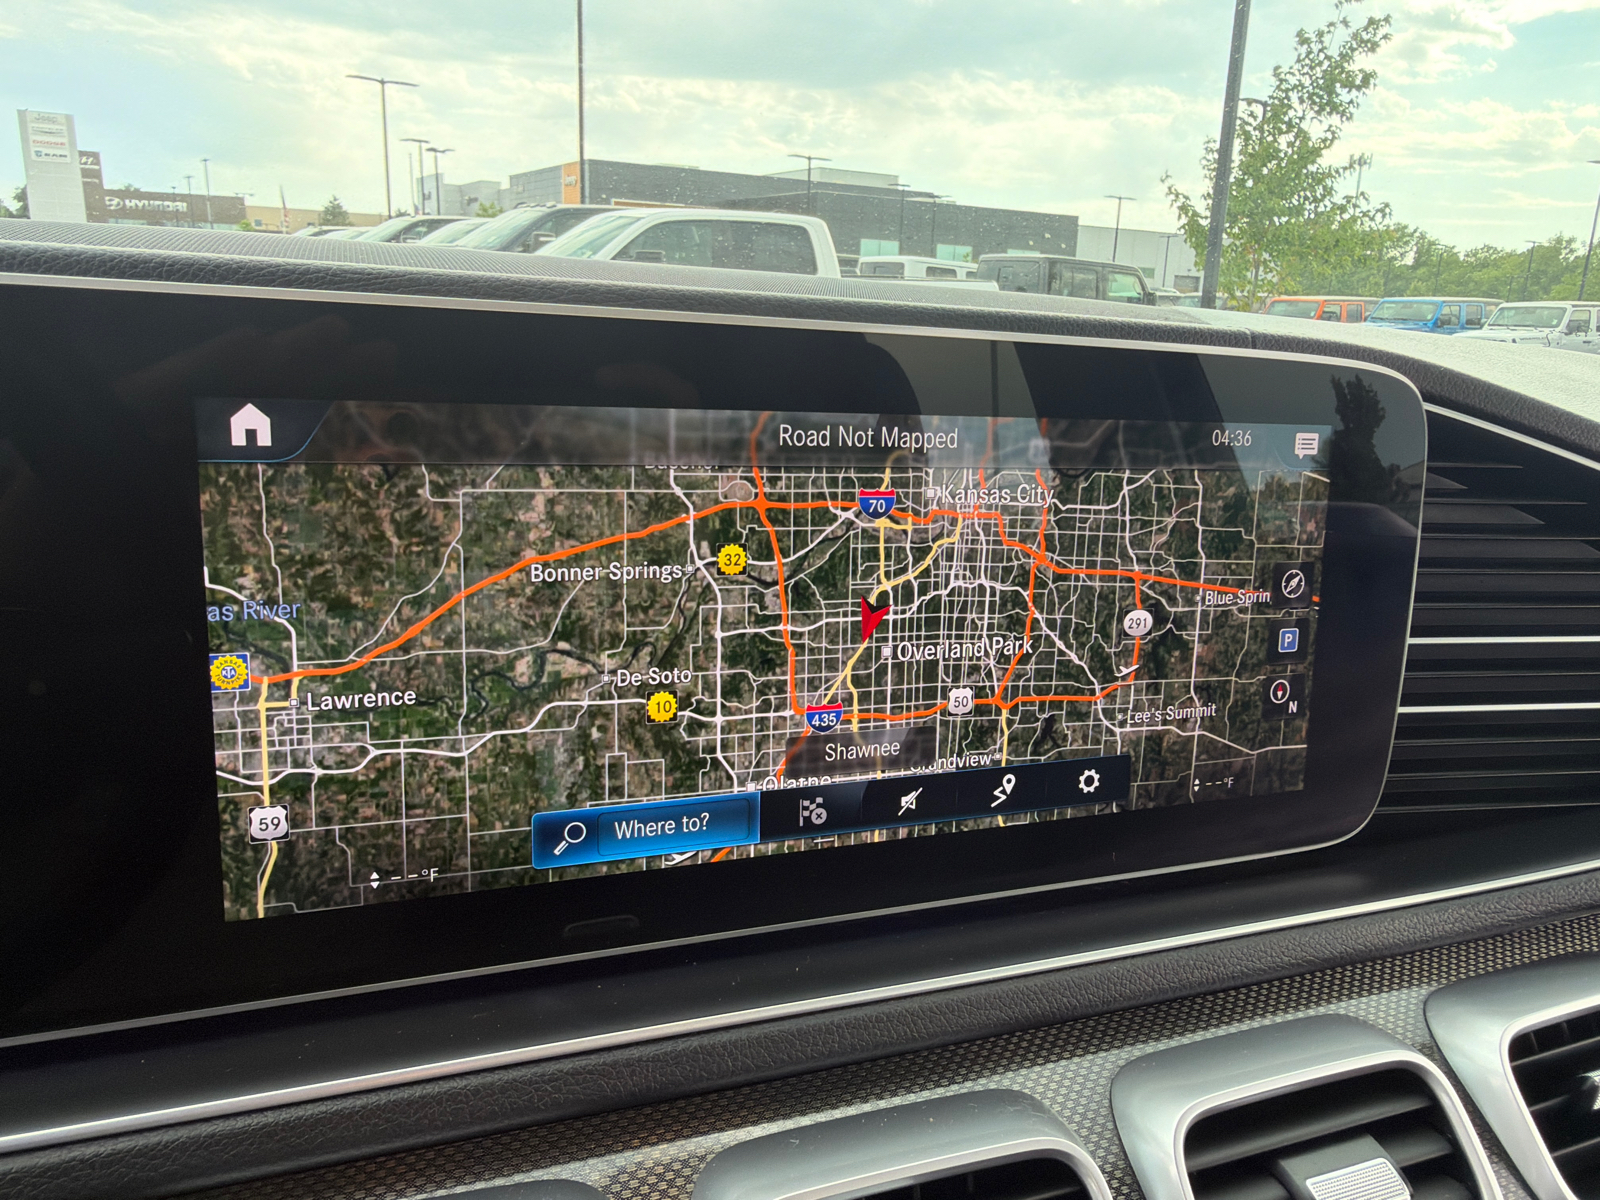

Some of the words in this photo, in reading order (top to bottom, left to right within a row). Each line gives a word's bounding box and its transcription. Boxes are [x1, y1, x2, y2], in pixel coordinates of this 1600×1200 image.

[125, 199, 187, 212] HYUNDAI
[779, 424, 831, 447] Road
[838, 425, 873, 448] Not
[880, 426, 959, 453] Mapped
[1211, 429, 1252, 447] 04:36
[941, 485, 1008, 504] Kansas
[1016, 484, 1054, 509] City
[868, 500, 886, 514] 70
[723, 553, 742, 567] 32
[530, 564, 602, 582] Bonner
[609, 562, 682, 583] Springs
[1205, 591, 1233, 605] Blue
[243, 600, 301, 620] River
[1128, 617, 1148, 630] 291
[897, 642, 985, 662] Overland
[992, 637, 1033, 655] Park
[616, 670, 642, 687] De
[648, 667, 692, 684] Soto
[306, 690, 417, 711] Lawrence
[655, 700, 672, 715] 10
[953, 695, 969, 708] 50
[1288, 701, 1298, 714] N
[811, 713, 837, 728] 435
[1127, 708, 1162, 724] Lee's
[1165, 703, 1217, 720] Summit
[825, 741, 901, 762] Shawnee
[258, 817, 281, 832] 59
[614, 818, 676, 840] Where
[682, 812, 710, 832] to?
